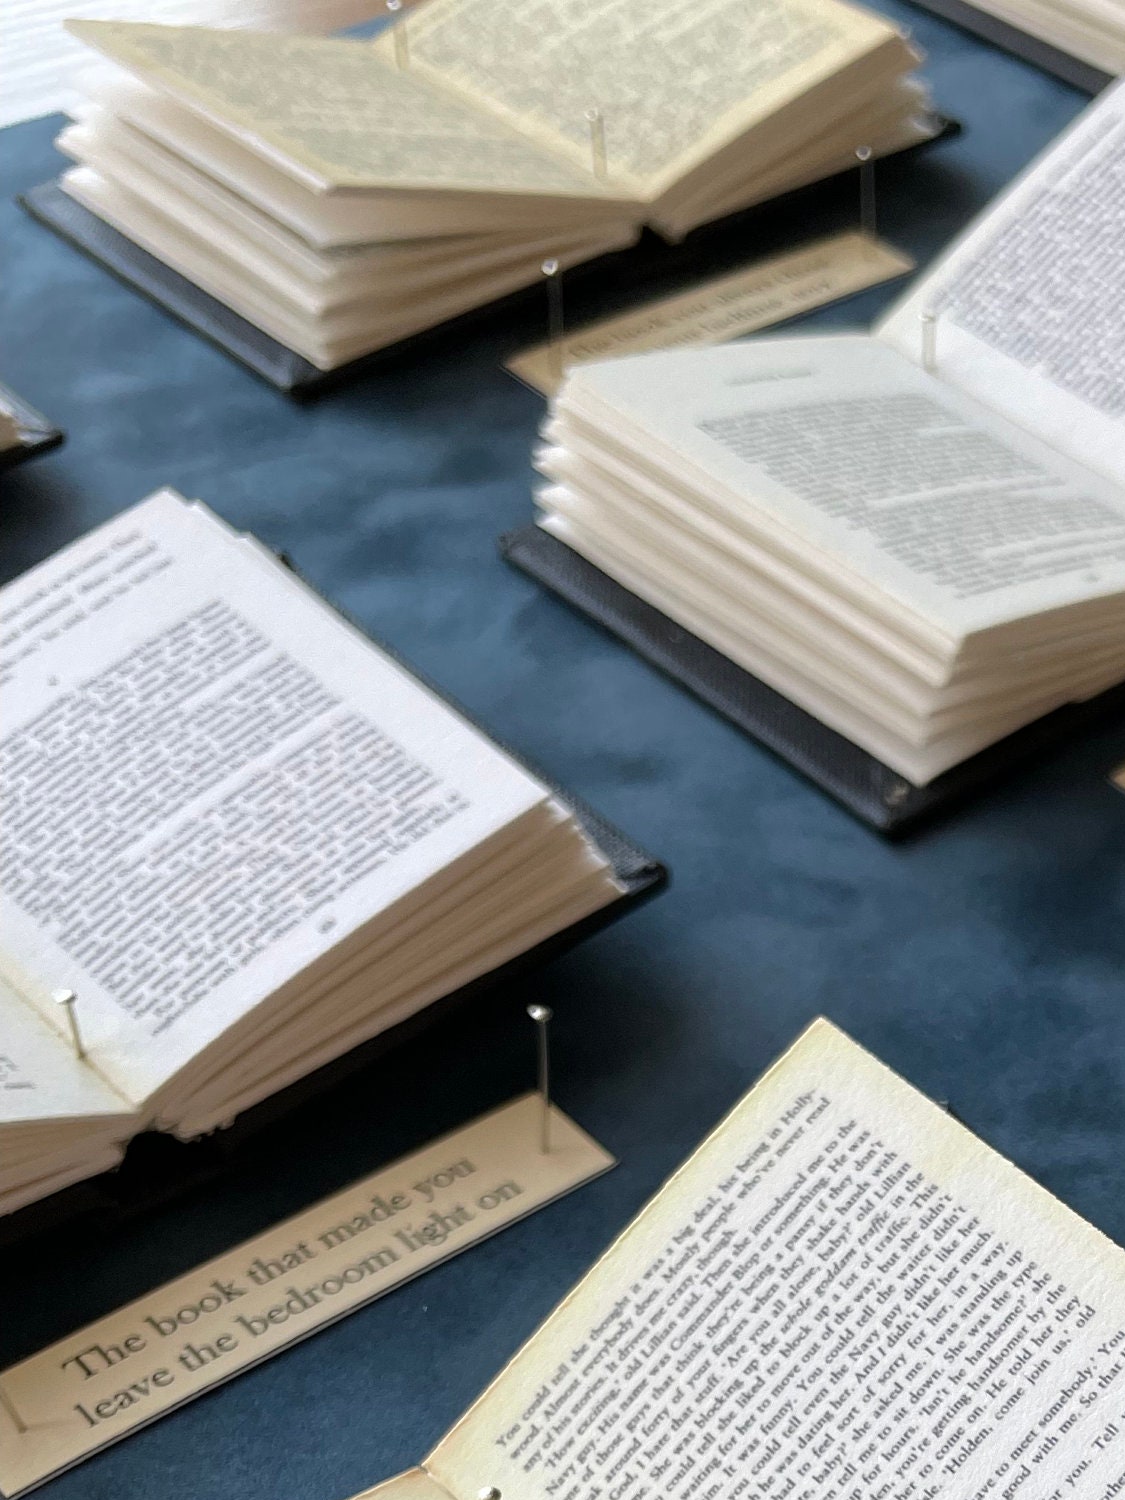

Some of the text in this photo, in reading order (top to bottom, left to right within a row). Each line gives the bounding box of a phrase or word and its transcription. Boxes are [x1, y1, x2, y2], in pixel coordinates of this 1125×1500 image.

[58, 1158, 477, 1381] The book that made you
[72, 1179, 524, 1429] leave the bedroom light on
